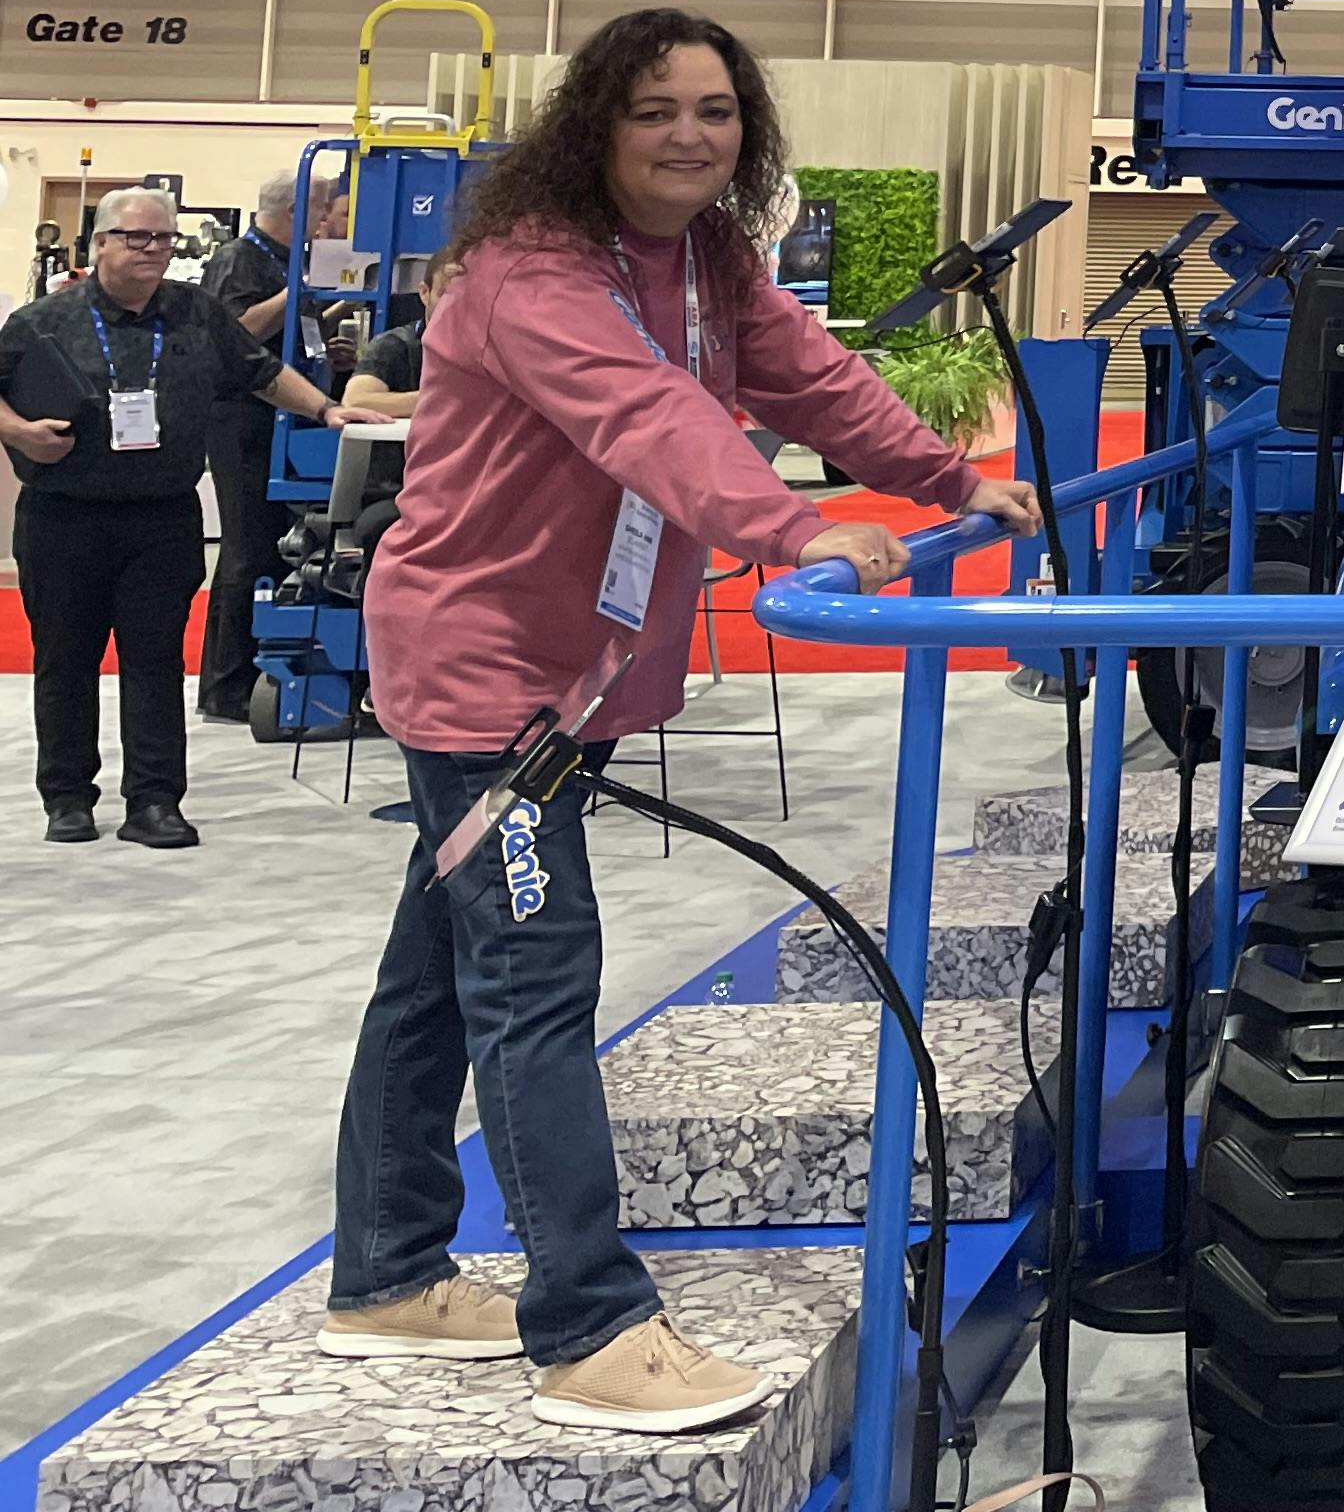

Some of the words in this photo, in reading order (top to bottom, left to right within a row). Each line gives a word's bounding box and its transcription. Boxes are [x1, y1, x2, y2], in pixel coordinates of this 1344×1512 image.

[26, 13, 124, 44] Gate
[144, 14, 188, 46] 18
[498, 797, 551, 923] Genie
